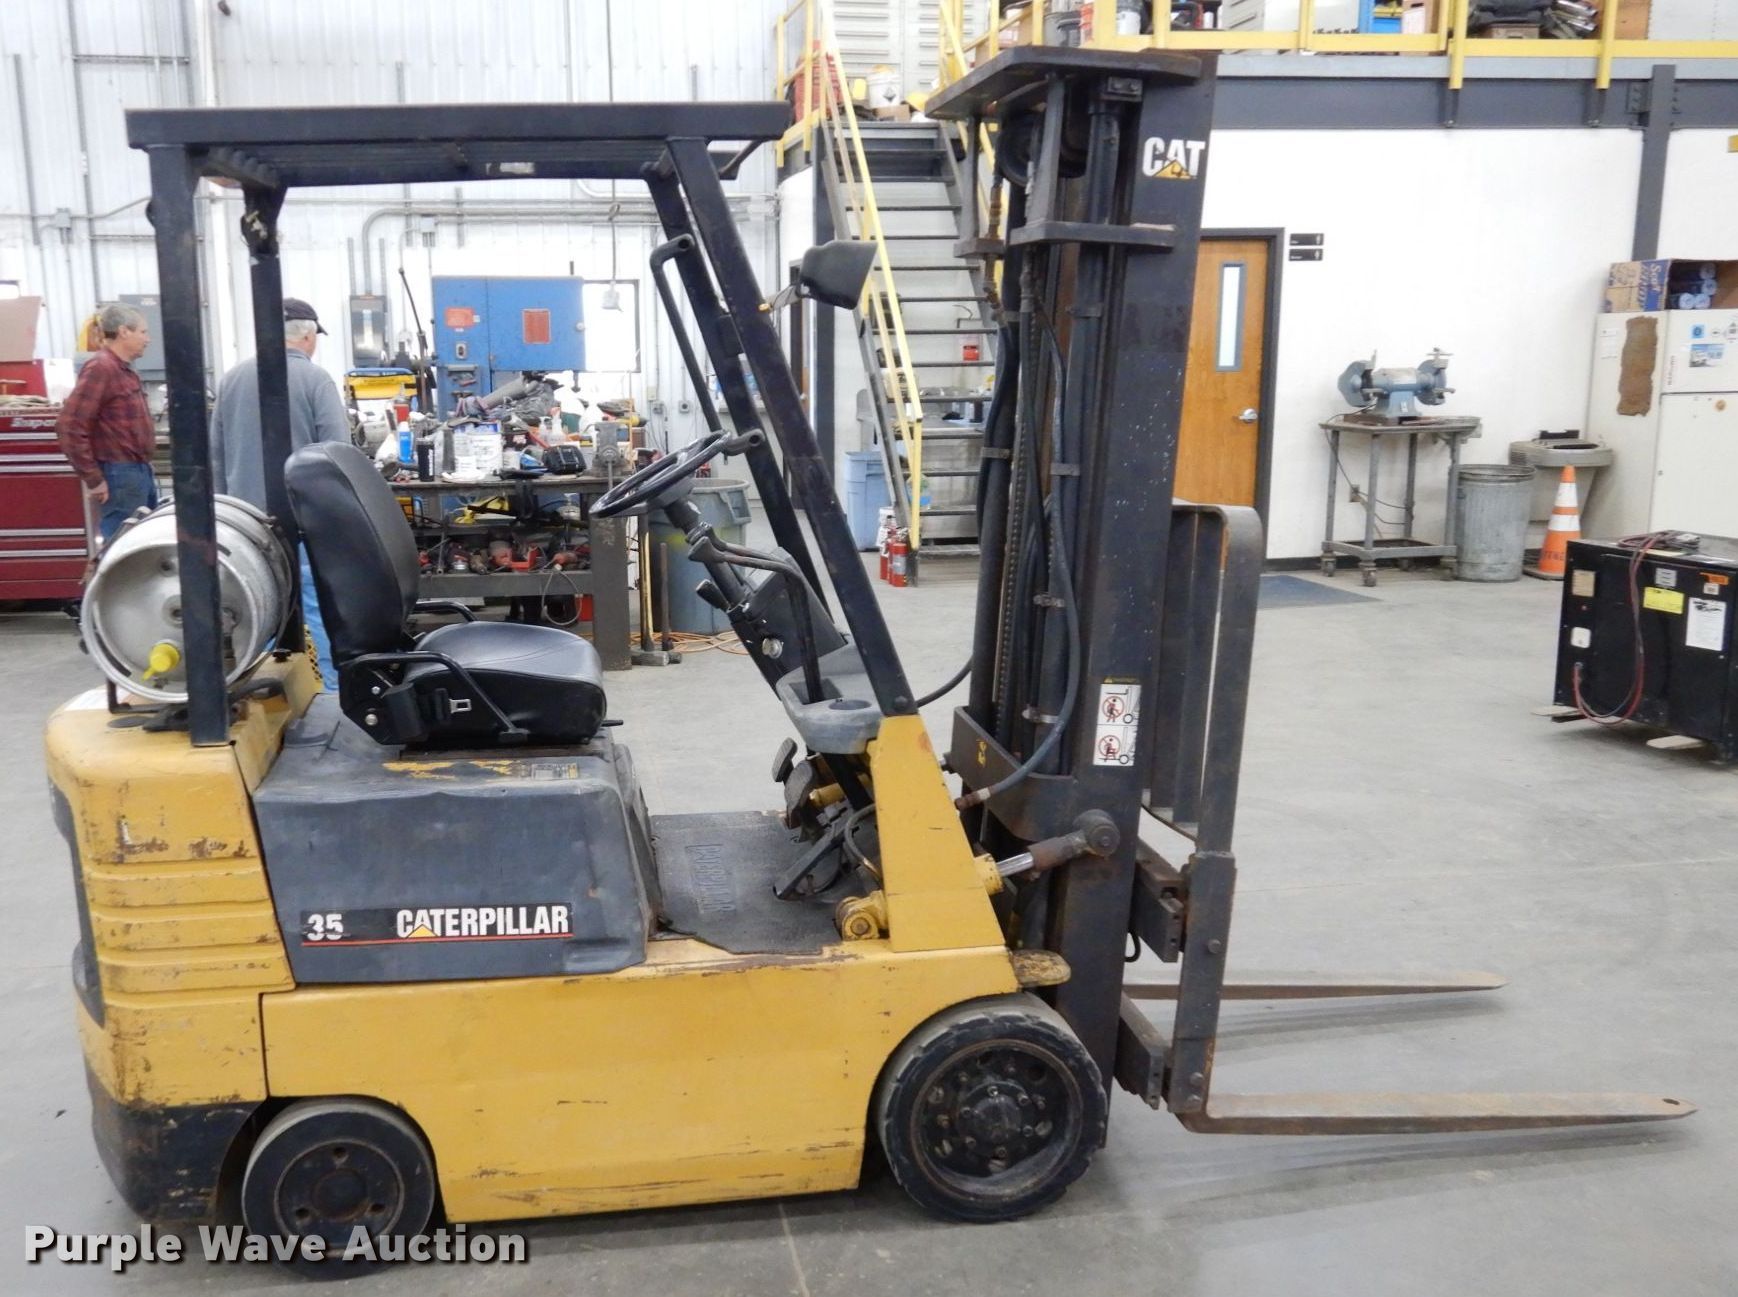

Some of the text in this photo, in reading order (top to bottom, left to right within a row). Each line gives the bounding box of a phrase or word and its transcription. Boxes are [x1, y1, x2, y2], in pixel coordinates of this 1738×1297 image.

[1142, 136, 1206, 177] CAT
[306, 913, 345, 941] 35
[396, 905, 569, 938] CATERPILLAR
